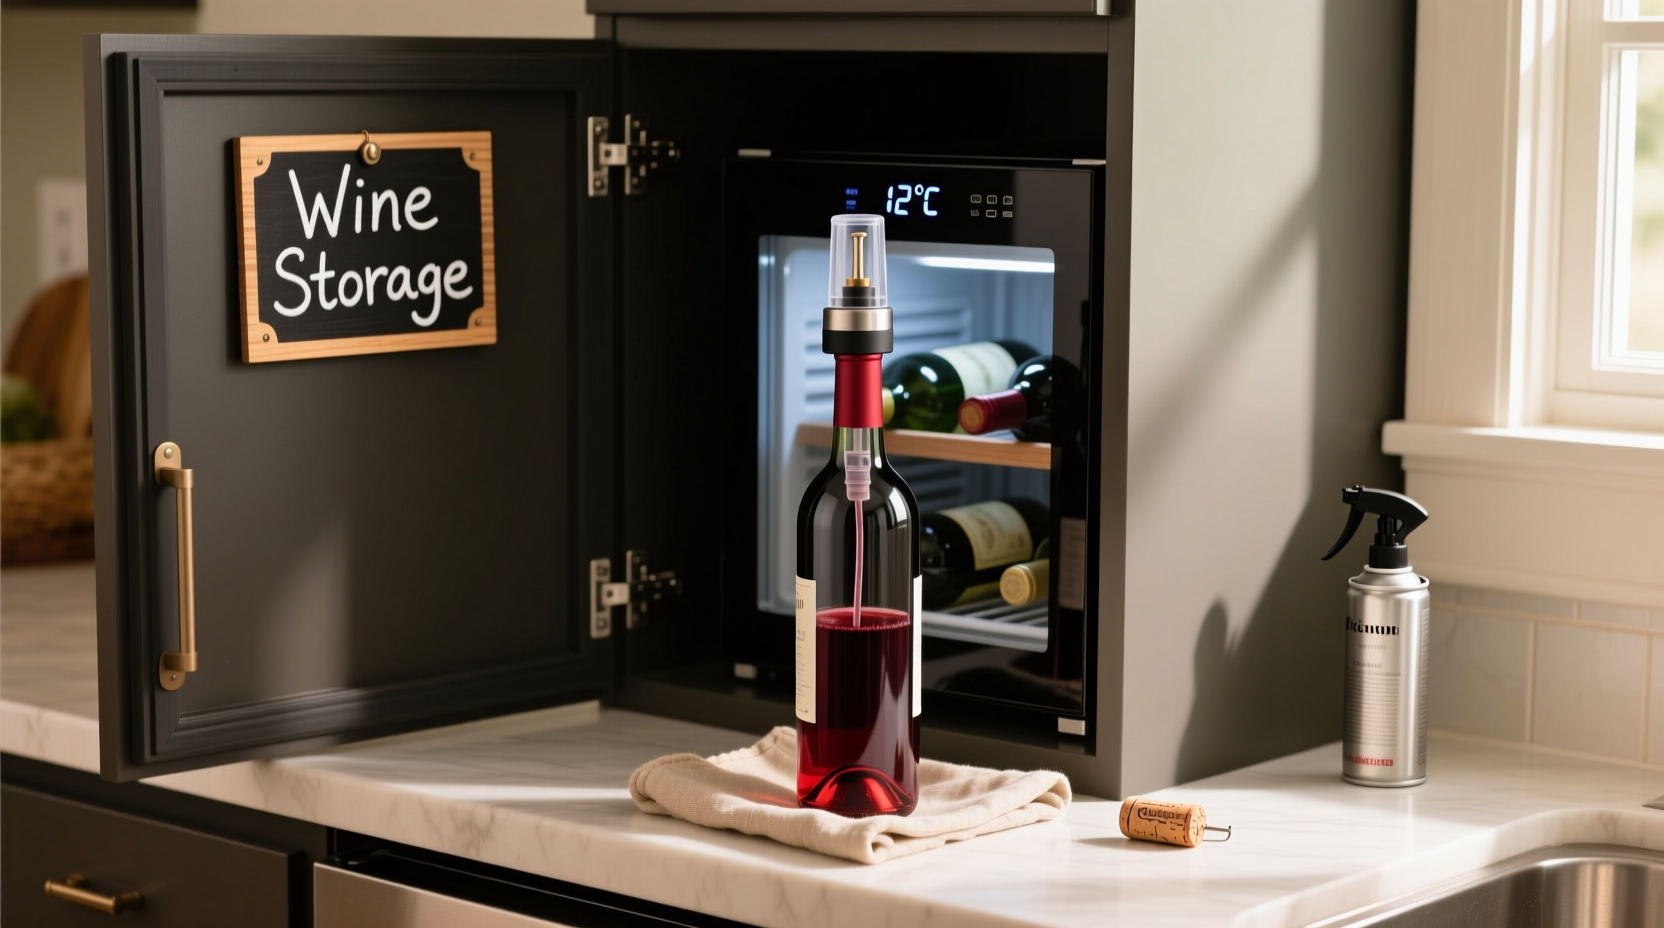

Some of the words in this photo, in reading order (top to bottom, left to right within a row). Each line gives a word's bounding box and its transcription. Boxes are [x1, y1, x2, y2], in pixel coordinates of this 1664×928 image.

[288, 163, 438, 239] Wine
[886, 184, 940, 216] 12°C
[273, 246, 473, 327] Storage
